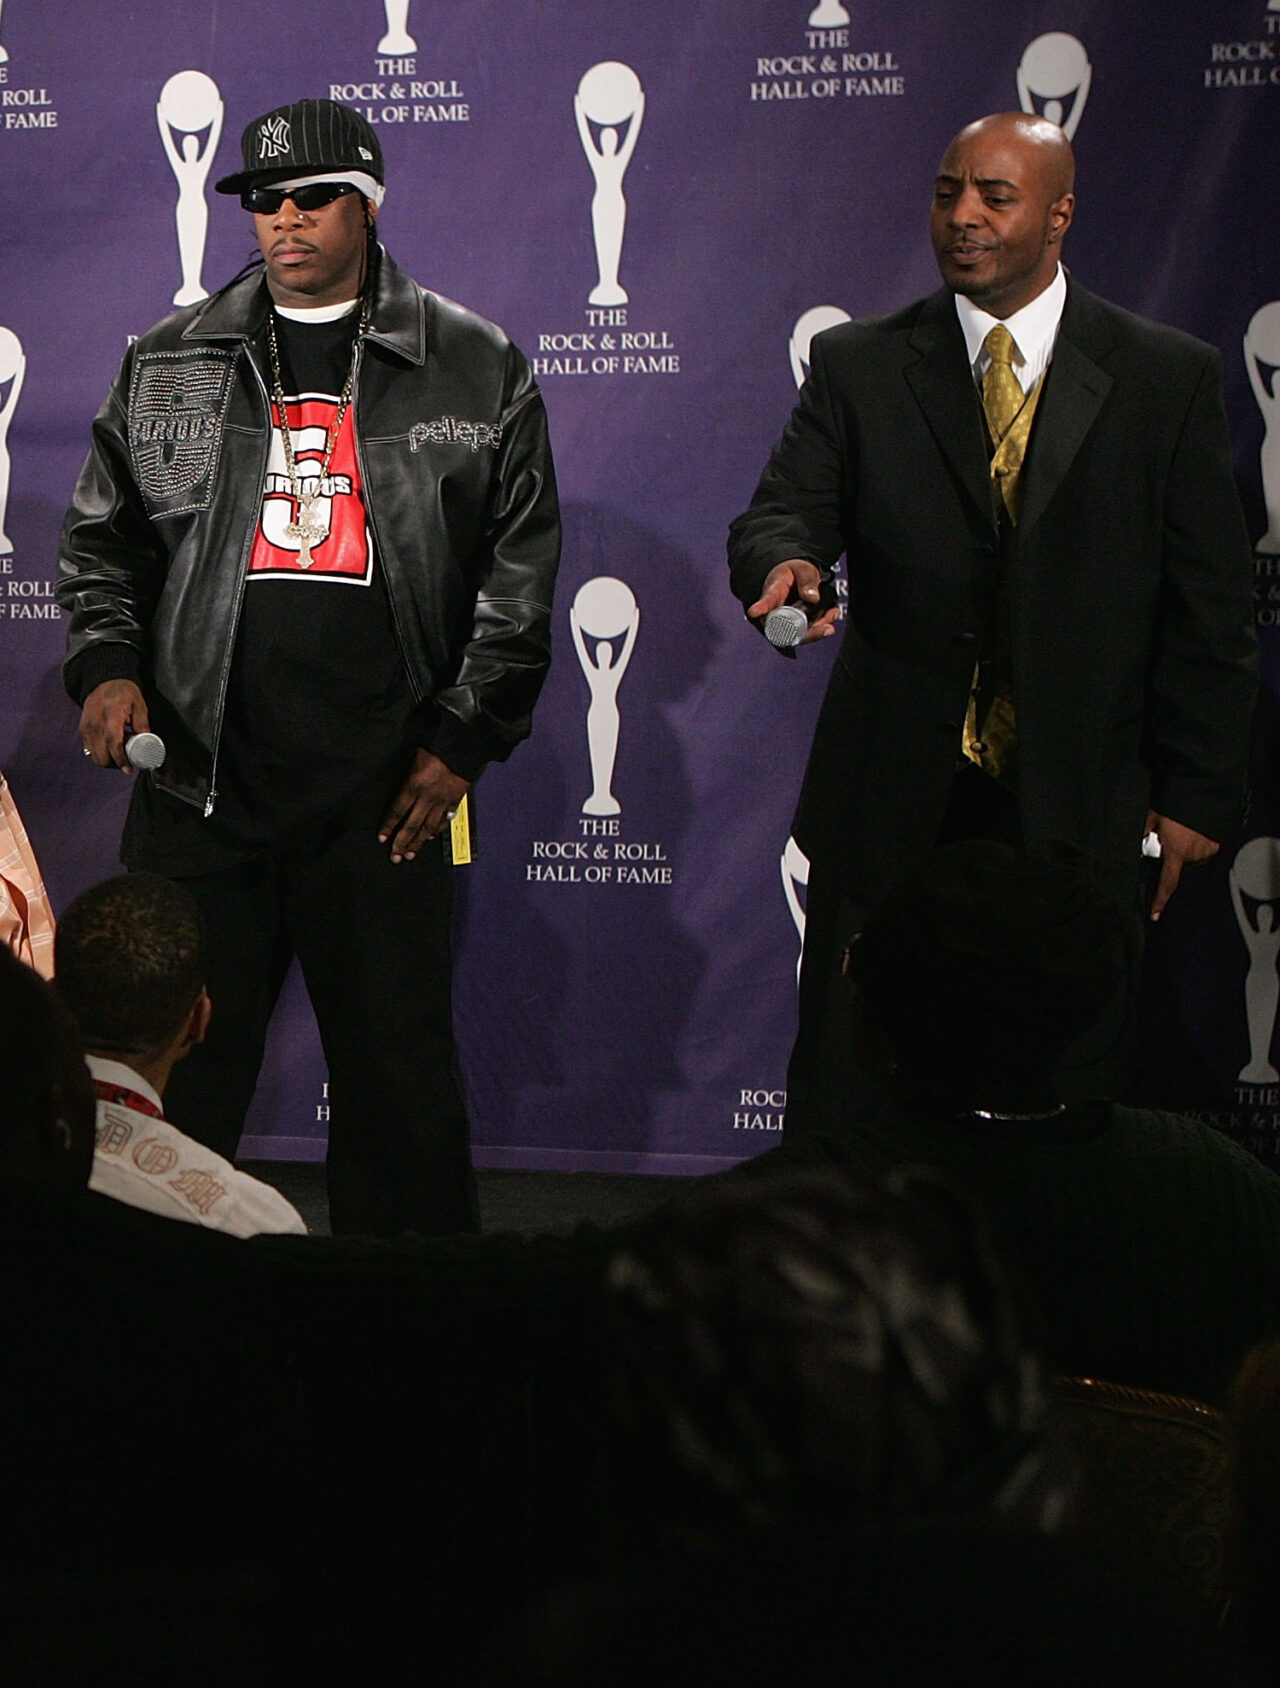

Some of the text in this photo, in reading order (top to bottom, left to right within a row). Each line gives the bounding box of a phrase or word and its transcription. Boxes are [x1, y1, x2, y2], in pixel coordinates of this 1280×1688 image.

[805, 29, 850, 50] THE
[1211, 42, 1275, 62] ROCK
[374, 58, 417, 76] THE
[756, 52, 899, 76] ROCK & ROLL
[1204, 67, 1267, 88] HALL
[1, 88, 52, 107] ROLL
[329, 80, 464, 101] ROCK & ROLL
[750, 77, 904, 101] HALL OF FAME
[5, 111, 58, 129] FAME
[381, 105, 410, 123] OF
[413, 103, 470, 122] FAME
[585, 309, 627, 327] THE
[538, 331, 674, 351] ROCK & ROLL
[532, 355, 680, 376] HALL OF FAME
[7, 581, 55, 597] ROLL
[10, 603, 62, 619] FAME
[579, 819, 621, 836] THE
[533, 841, 667, 861] ROCK & ROLL
[526, 864, 673, 884] HALL OF FAME
[740, 1089, 786, 1108] ROC
